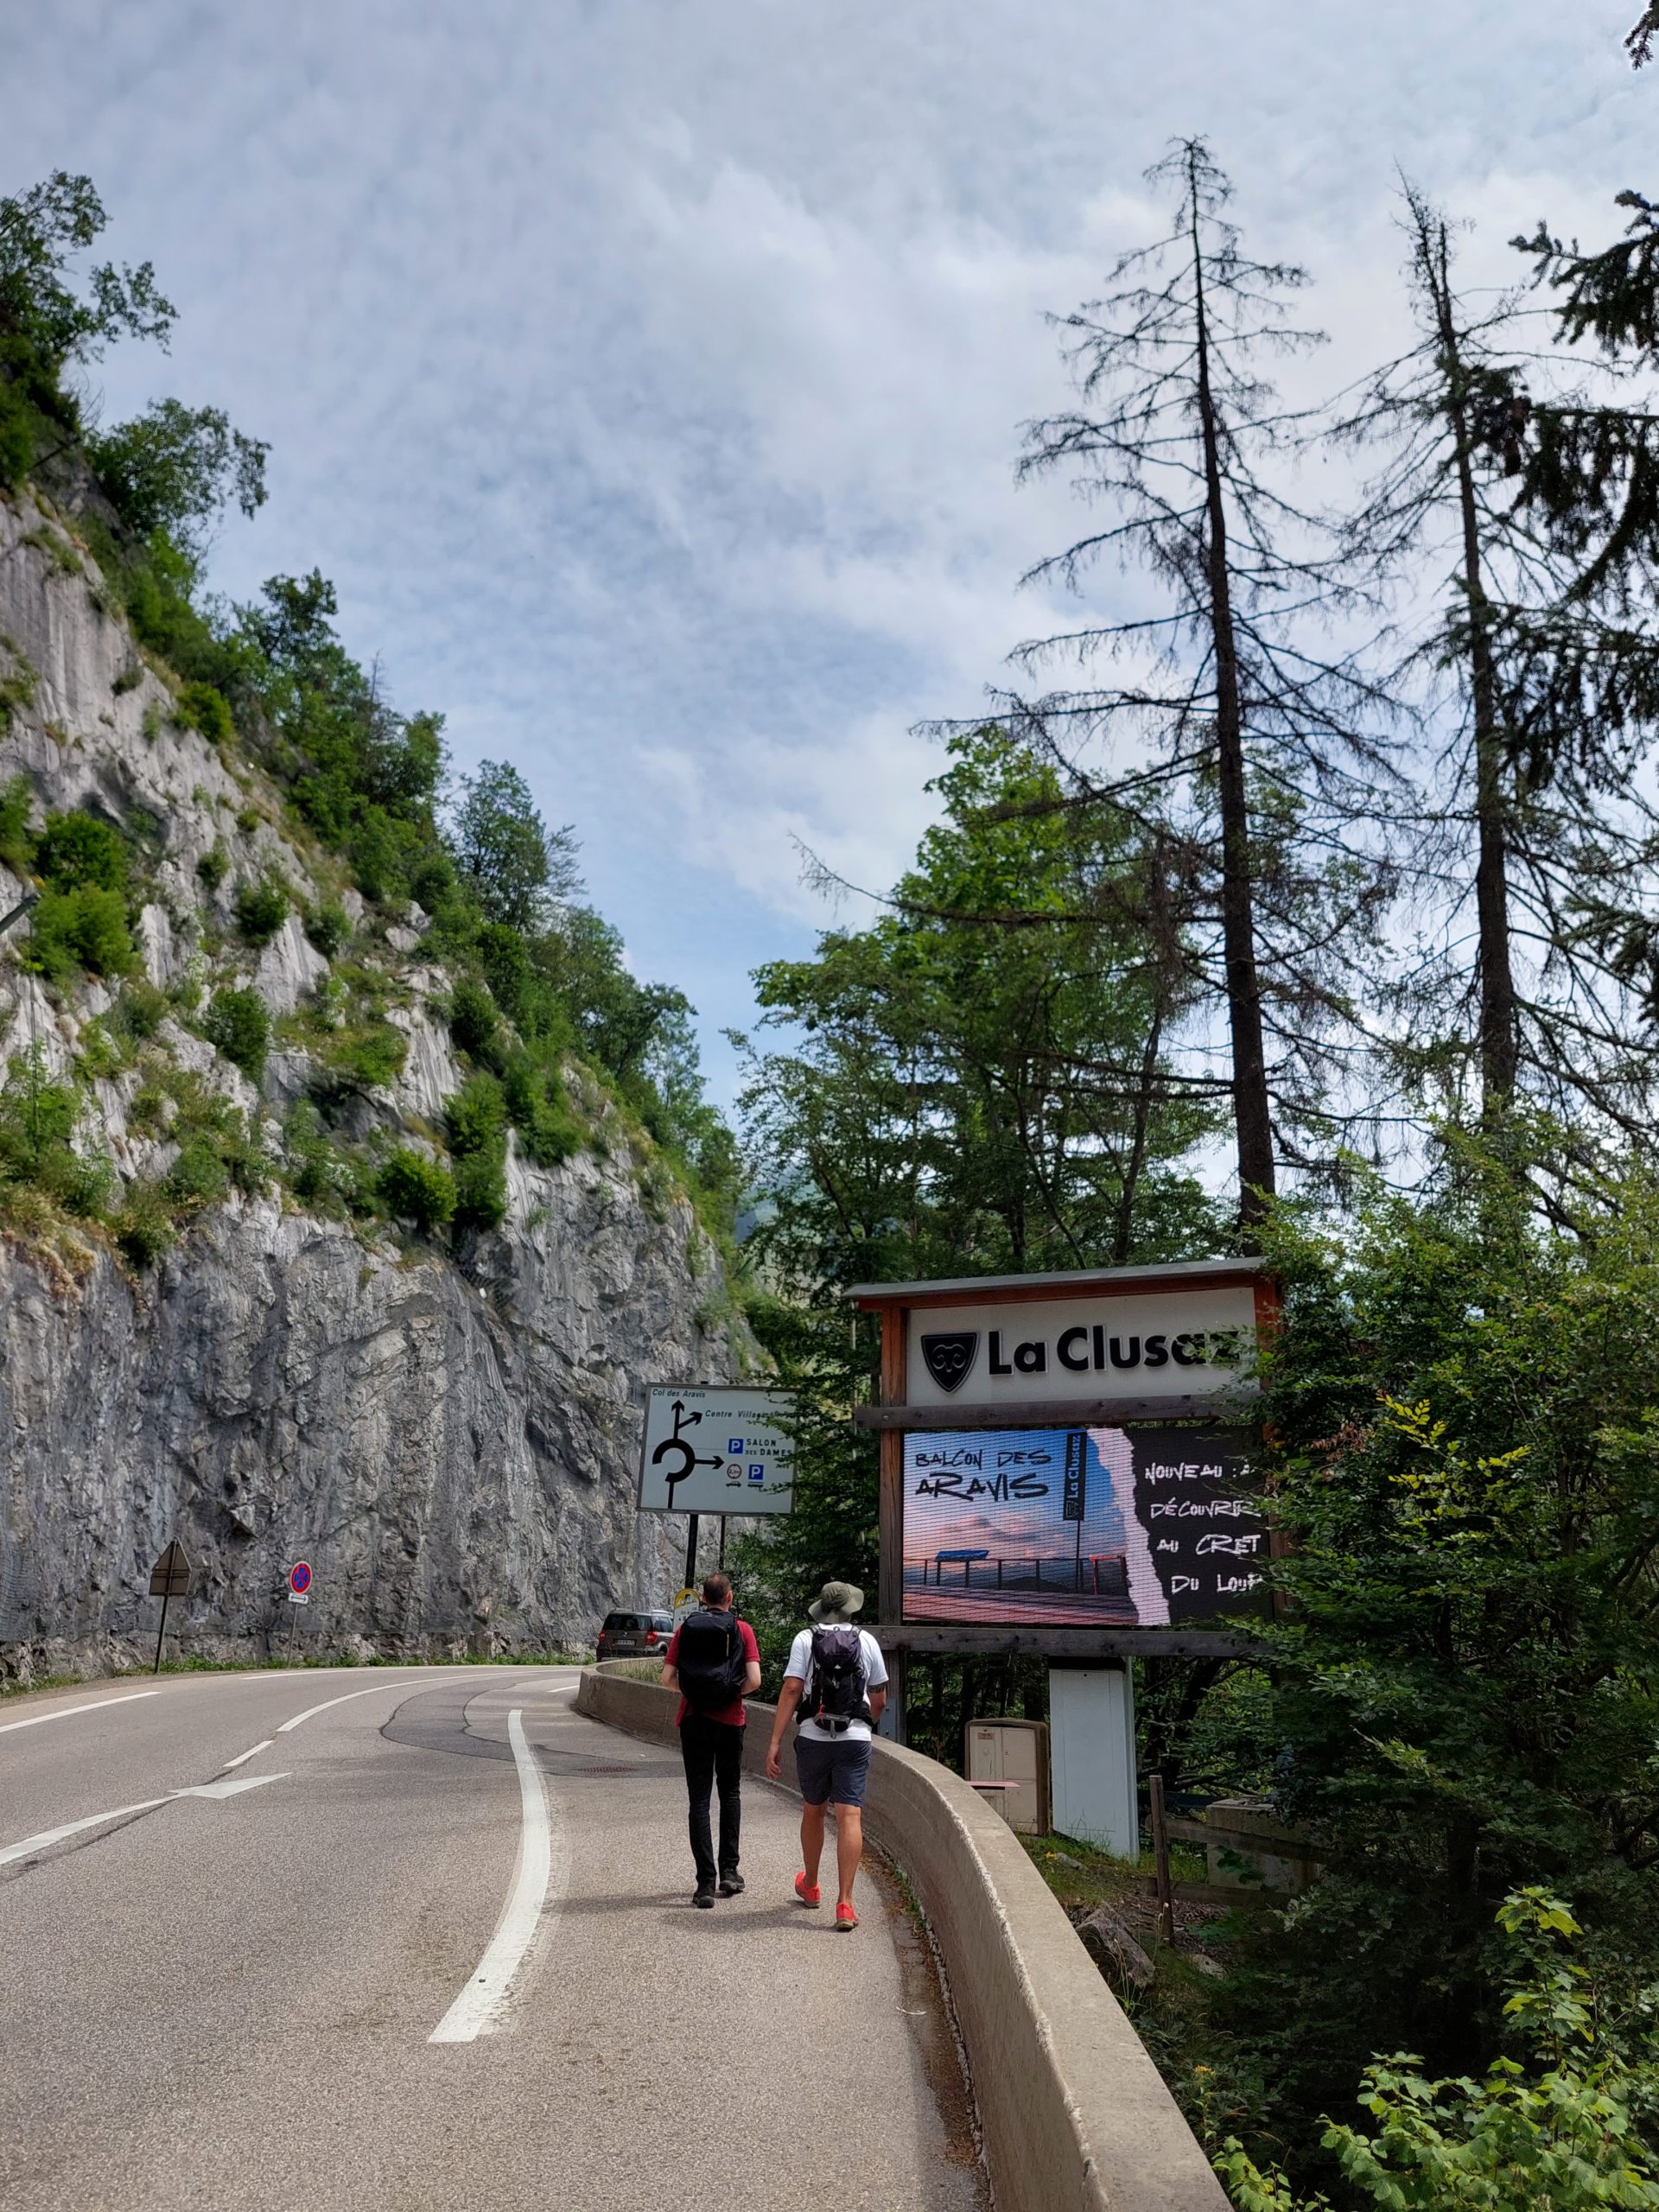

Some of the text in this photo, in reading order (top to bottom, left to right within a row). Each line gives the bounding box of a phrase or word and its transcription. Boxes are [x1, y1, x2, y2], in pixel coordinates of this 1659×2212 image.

[988, 1329, 1046, 1376] La
[652, 1388, 665, 1396] Col
[683, 1389, 706, 1398] Aravis
[705, 1409, 733, 1418] Centre
[746, 1438, 777, 1447] SALON
[916, 1448, 1052, 1470] BALCON DES
[1066, 1434, 1082, 1499] La Clusaz
[1145, 1462, 1223, 1485] NOUVEAU
[915, 1471, 1049, 1502] ARAVIS
[1156, 1534, 1262, 1555] AU CRET
[1171, 1575, 1200, 1595] DU
